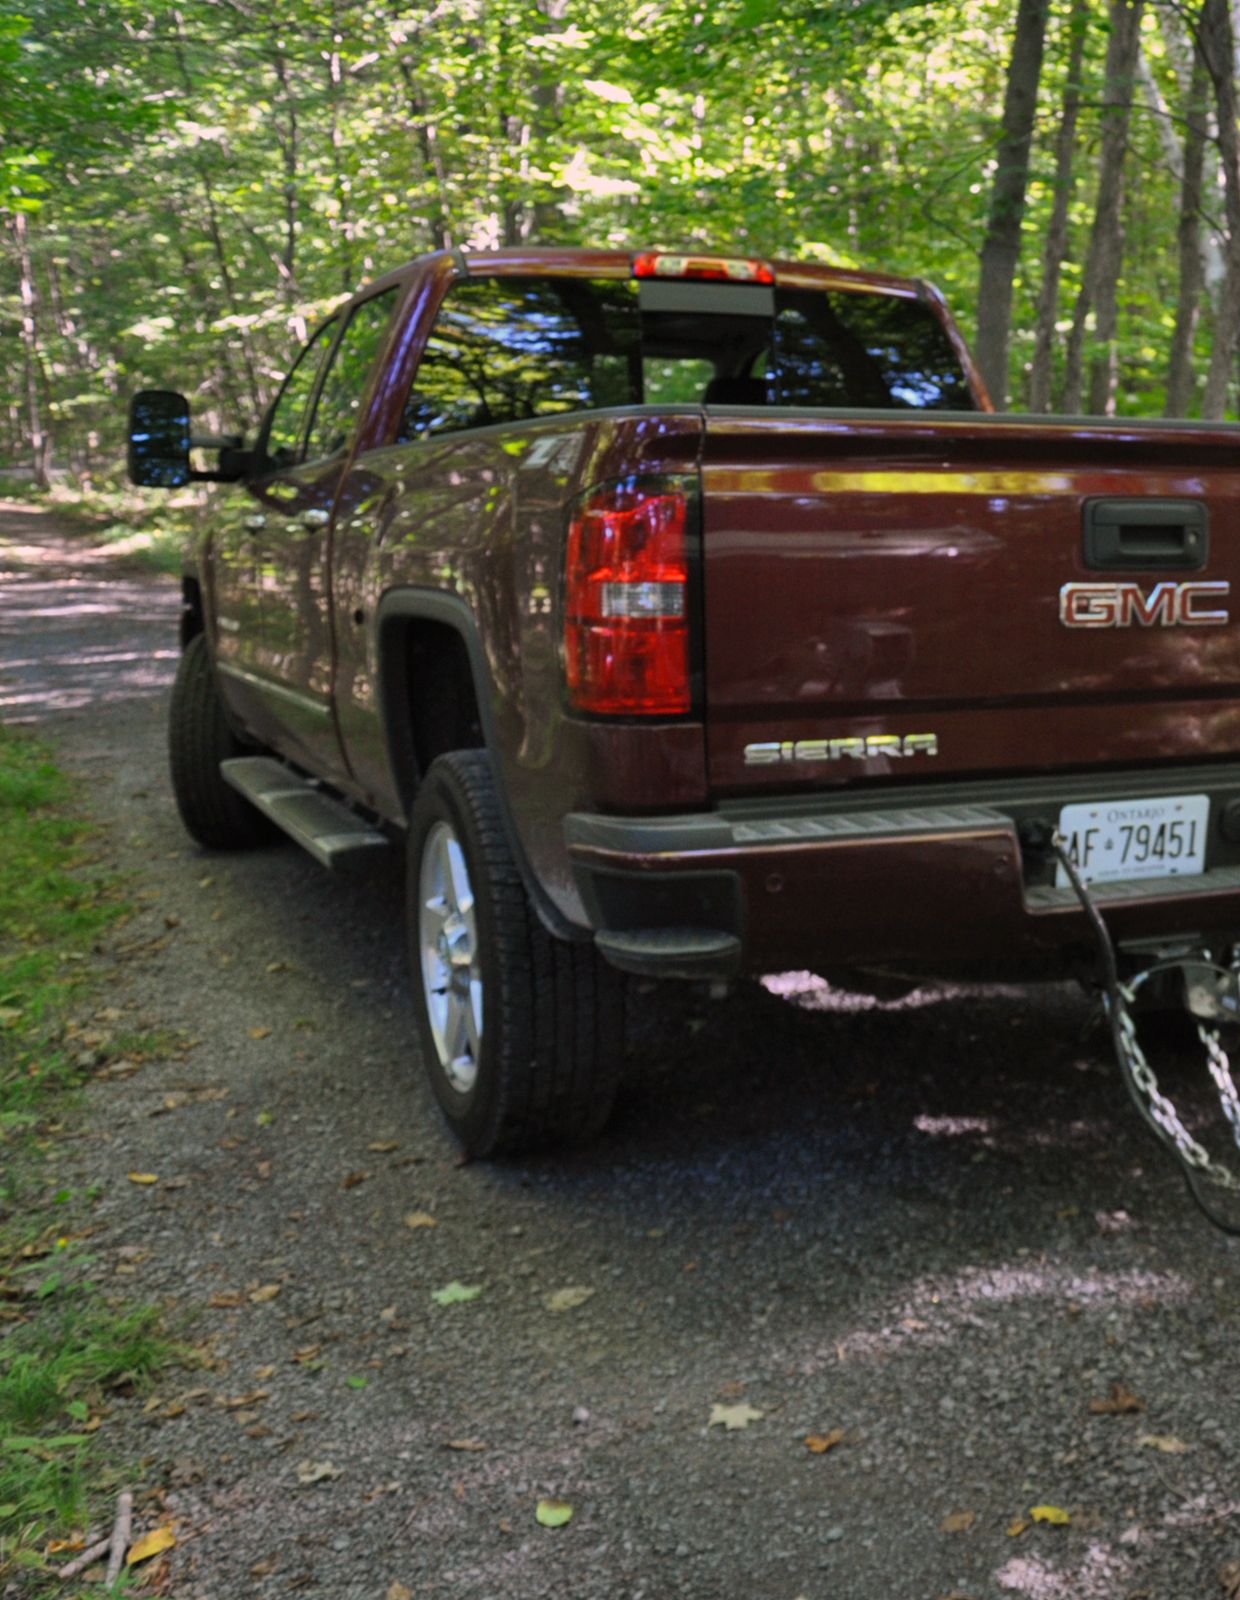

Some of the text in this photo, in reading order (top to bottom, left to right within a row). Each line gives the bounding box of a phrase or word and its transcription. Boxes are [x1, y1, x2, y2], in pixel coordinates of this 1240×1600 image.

[1059, 580, 1230, 628] GMC
[744, 733, 938, 765] SIERRA
[1107, 807, 1165, 823] ONTARIO
[1068, 820, 1197, 868] AF 79451
